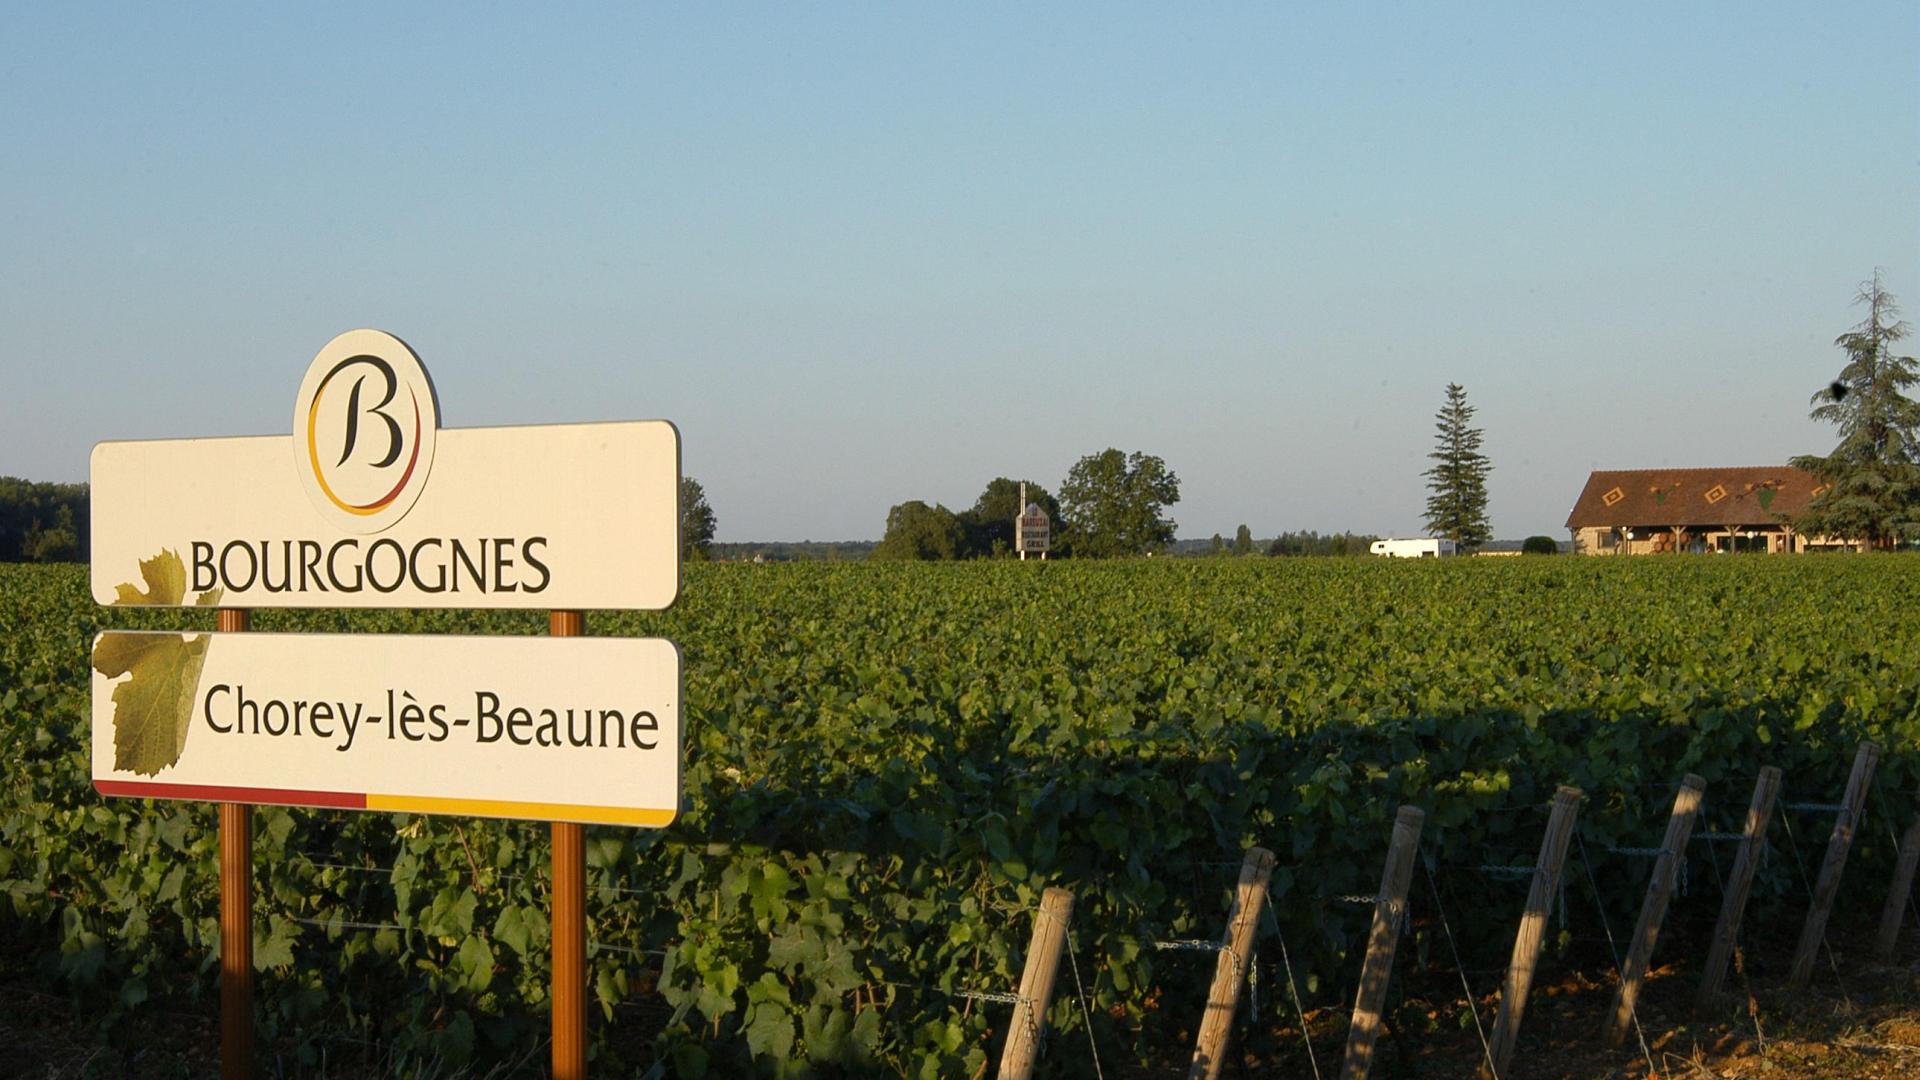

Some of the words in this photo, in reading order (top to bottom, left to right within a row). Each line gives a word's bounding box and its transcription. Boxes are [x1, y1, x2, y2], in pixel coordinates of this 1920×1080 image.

[311, 355, 403, 467] B
[192, 537, 550, 593] BOURGOGNES
[205, 685, 658, 752] Chorey-lès-Beaune
